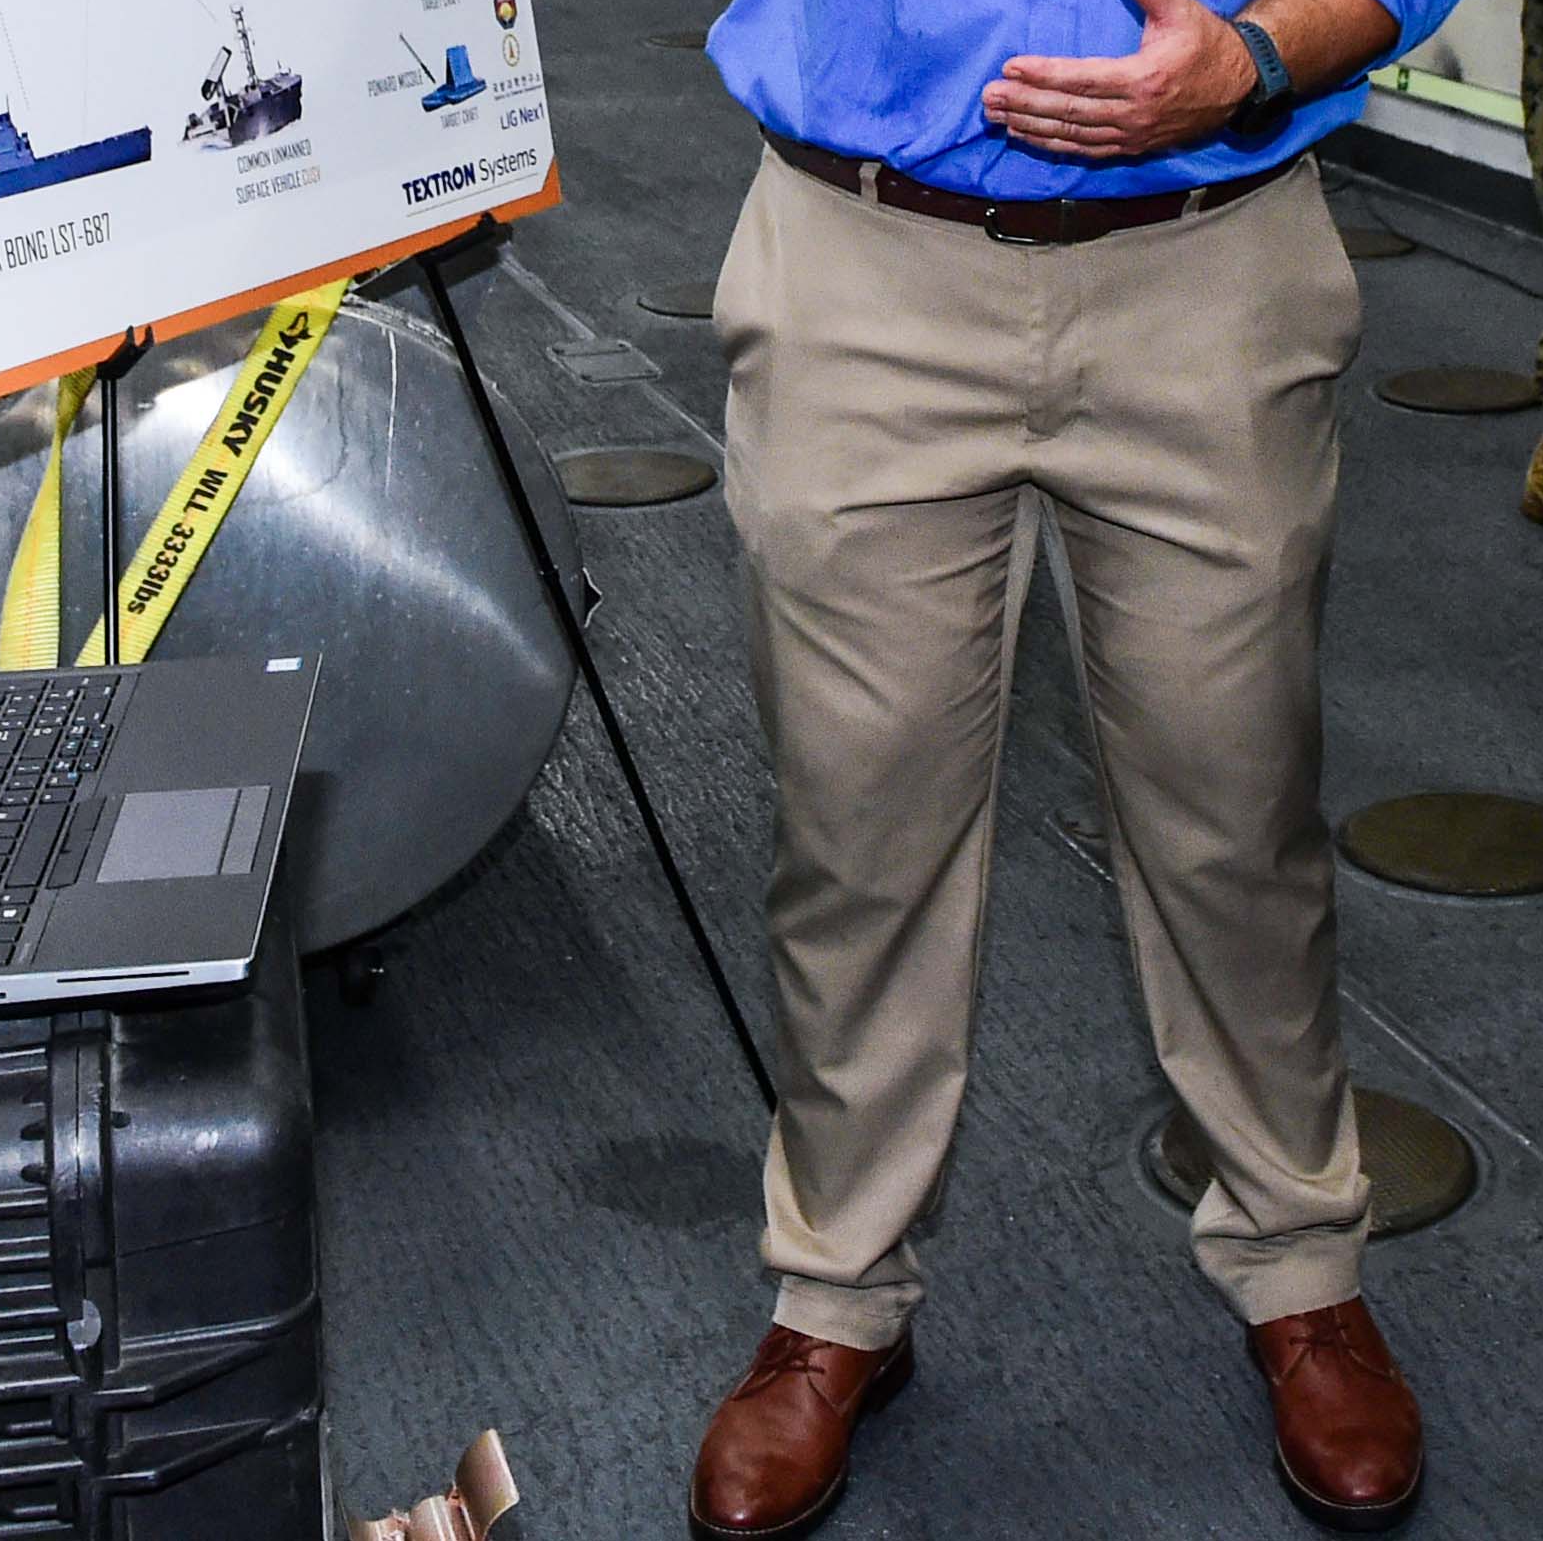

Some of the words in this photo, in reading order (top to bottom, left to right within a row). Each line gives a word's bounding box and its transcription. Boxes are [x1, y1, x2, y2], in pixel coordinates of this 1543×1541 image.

[500, 109, 519, 130] LIG
[519, 101, 545, 125] Nex1
[237, 151, 271, 174] COMMON
[271, 139, 312, 165] UNMANNED
[402, 162, 476, 205] TEXTRON
[478, 148, 537, 184] Systems
[236, 179, 271, 204] SURFACE
[271, 170, 301, 195] VEHICLE
[4, 230, 49, 269] BONG
[51, 212, 111, 256] LST-687
[223, 347, 295, 457] HUSKY
[184, 468, 228, 514] WLL
[127, 522, 194, 615] 3333lbs
